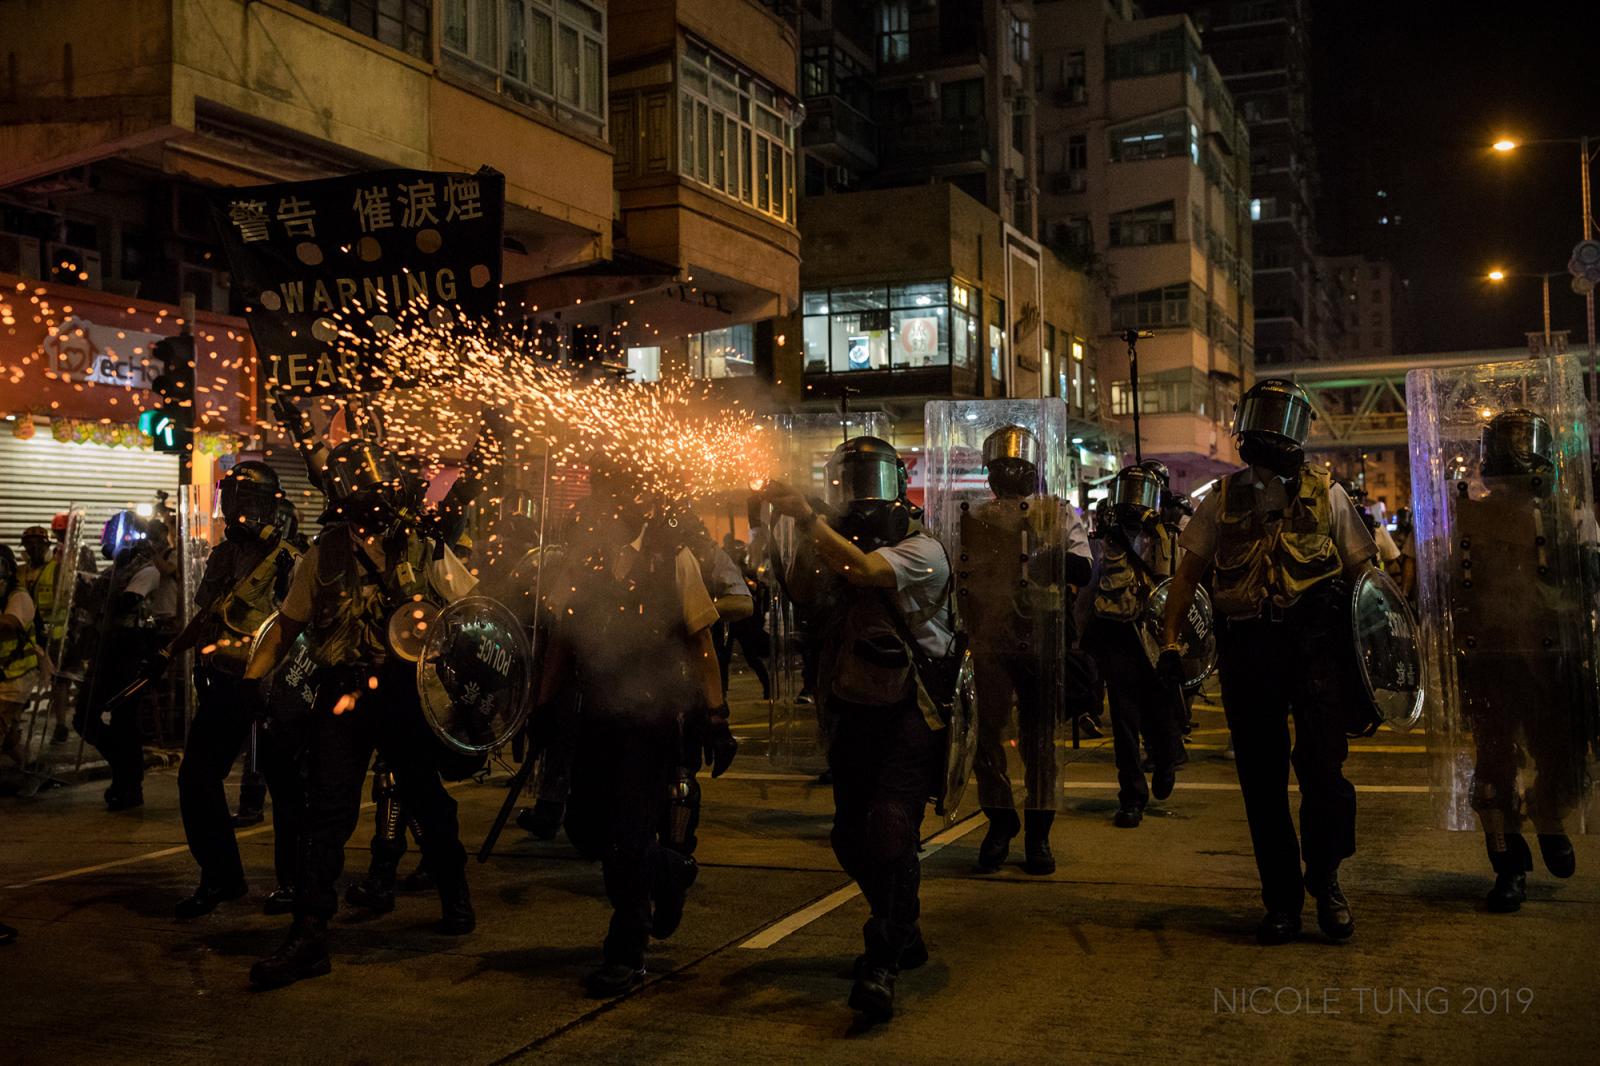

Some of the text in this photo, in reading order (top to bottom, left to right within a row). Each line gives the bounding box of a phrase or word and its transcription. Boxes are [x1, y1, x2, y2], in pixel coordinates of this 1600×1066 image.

[228, 174, 484, 244] 警告 催淚煙
[279, 267, 457, 314] WARNING
[268, 352, 362, 388] TEAR
[1187, 603, 1208, 641] POLICE
[475, 634, 513, 679] POLICE
